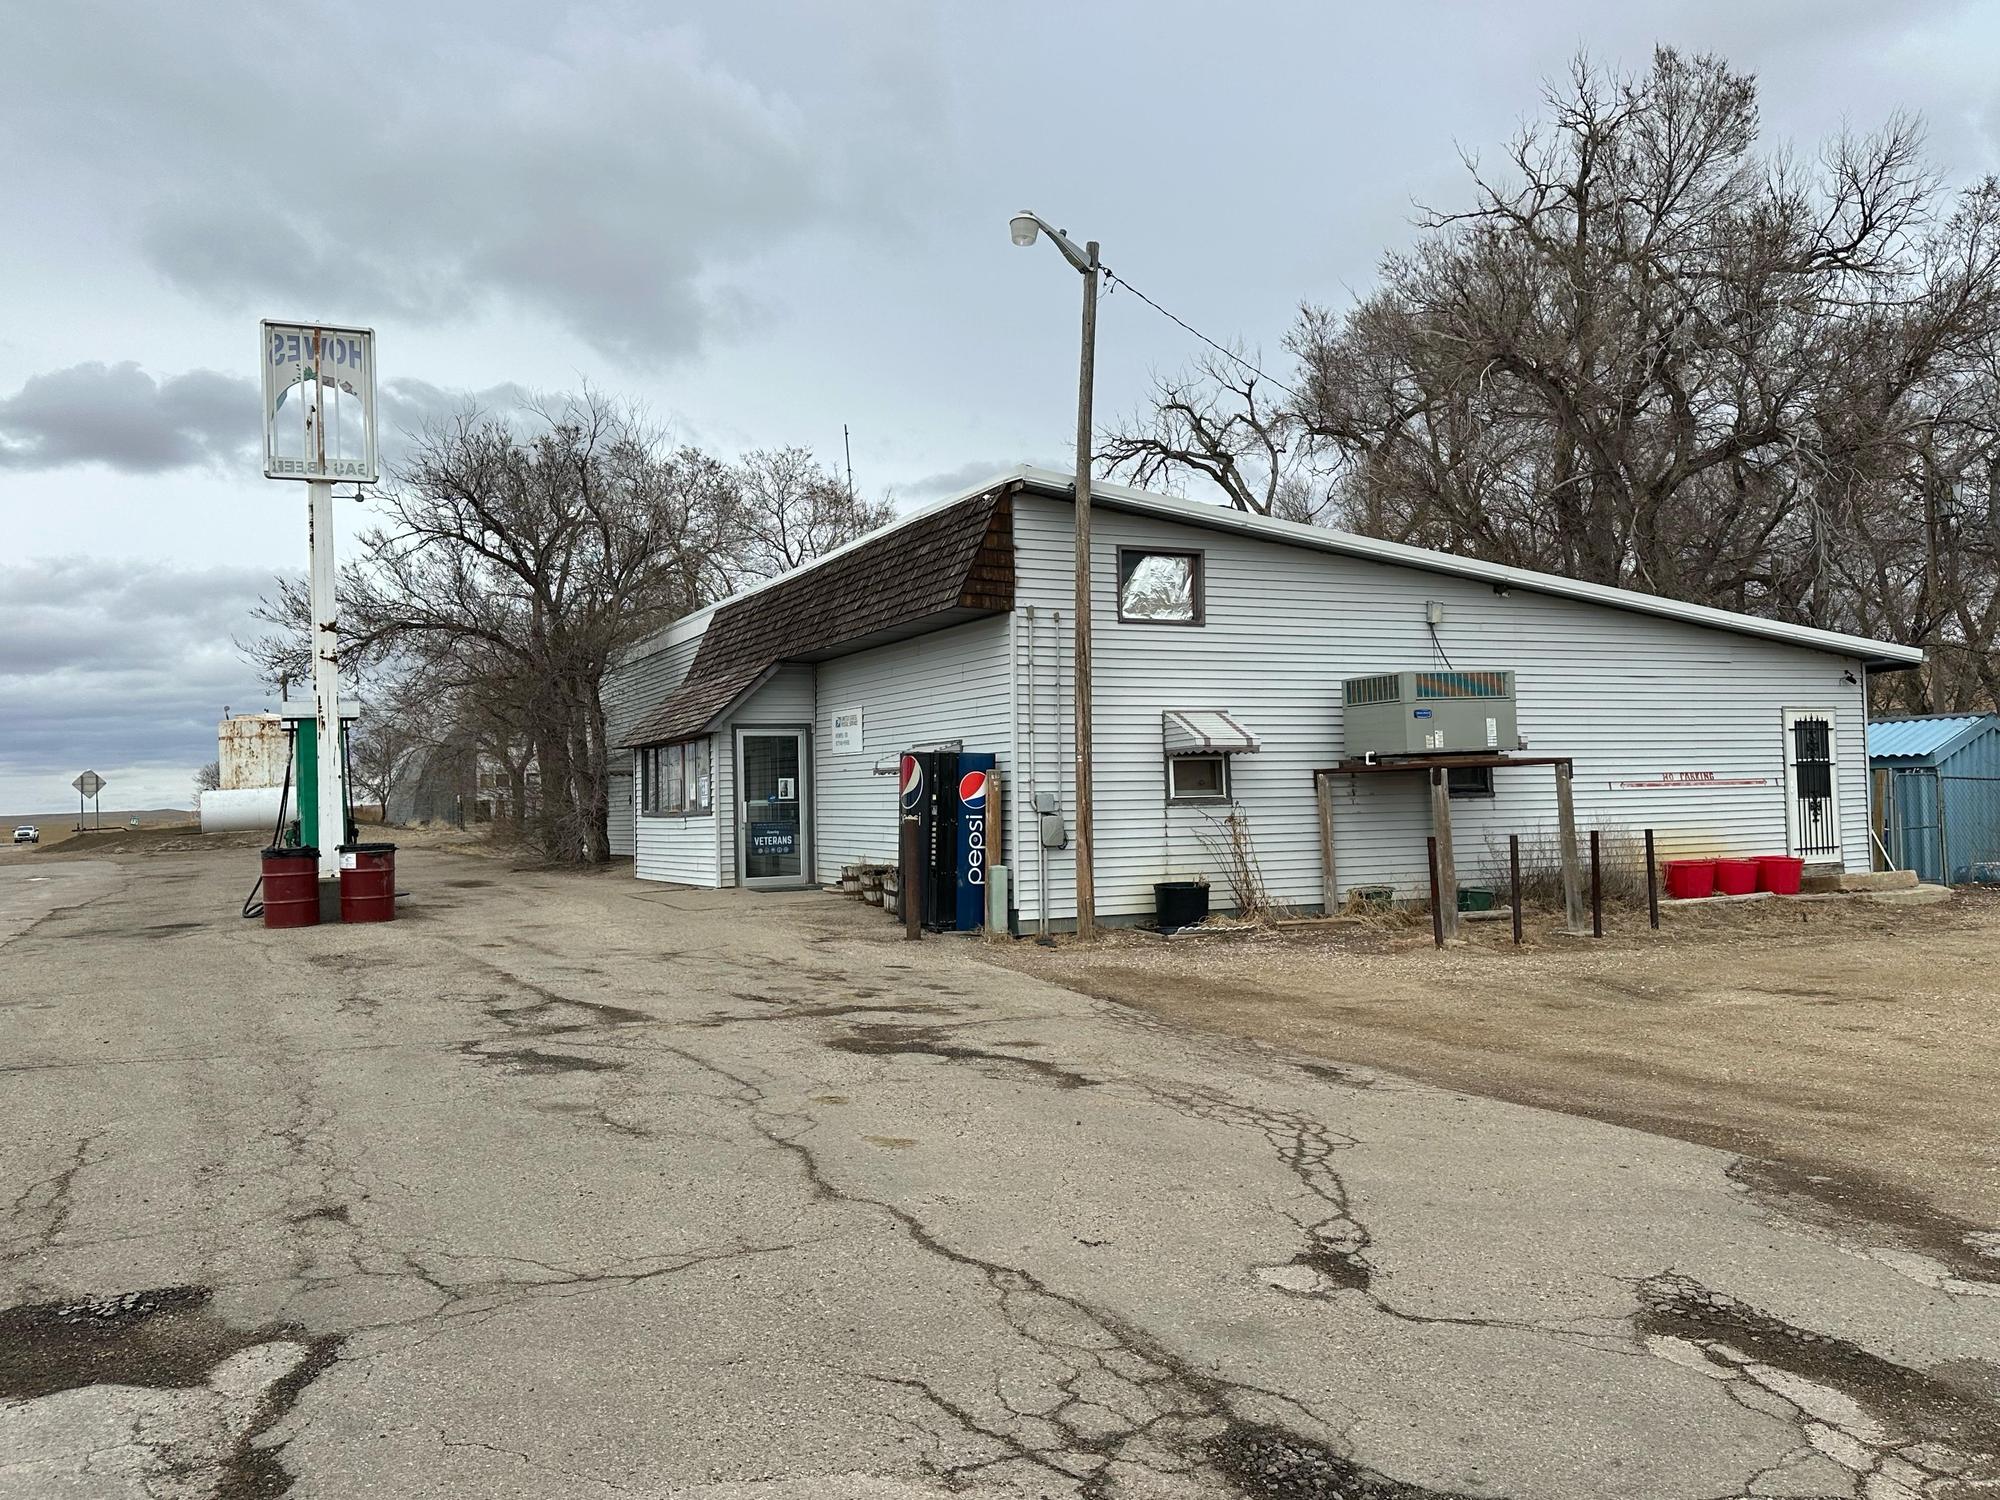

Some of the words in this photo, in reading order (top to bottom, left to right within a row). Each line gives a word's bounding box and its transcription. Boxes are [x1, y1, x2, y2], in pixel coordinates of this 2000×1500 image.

[1663, 772, 1674, 782] NO
[1680, 772, 1714, 781] PARKING
[754, 835, 792, 846] VETERANS
[966, 815, 986, 885] pepsi
